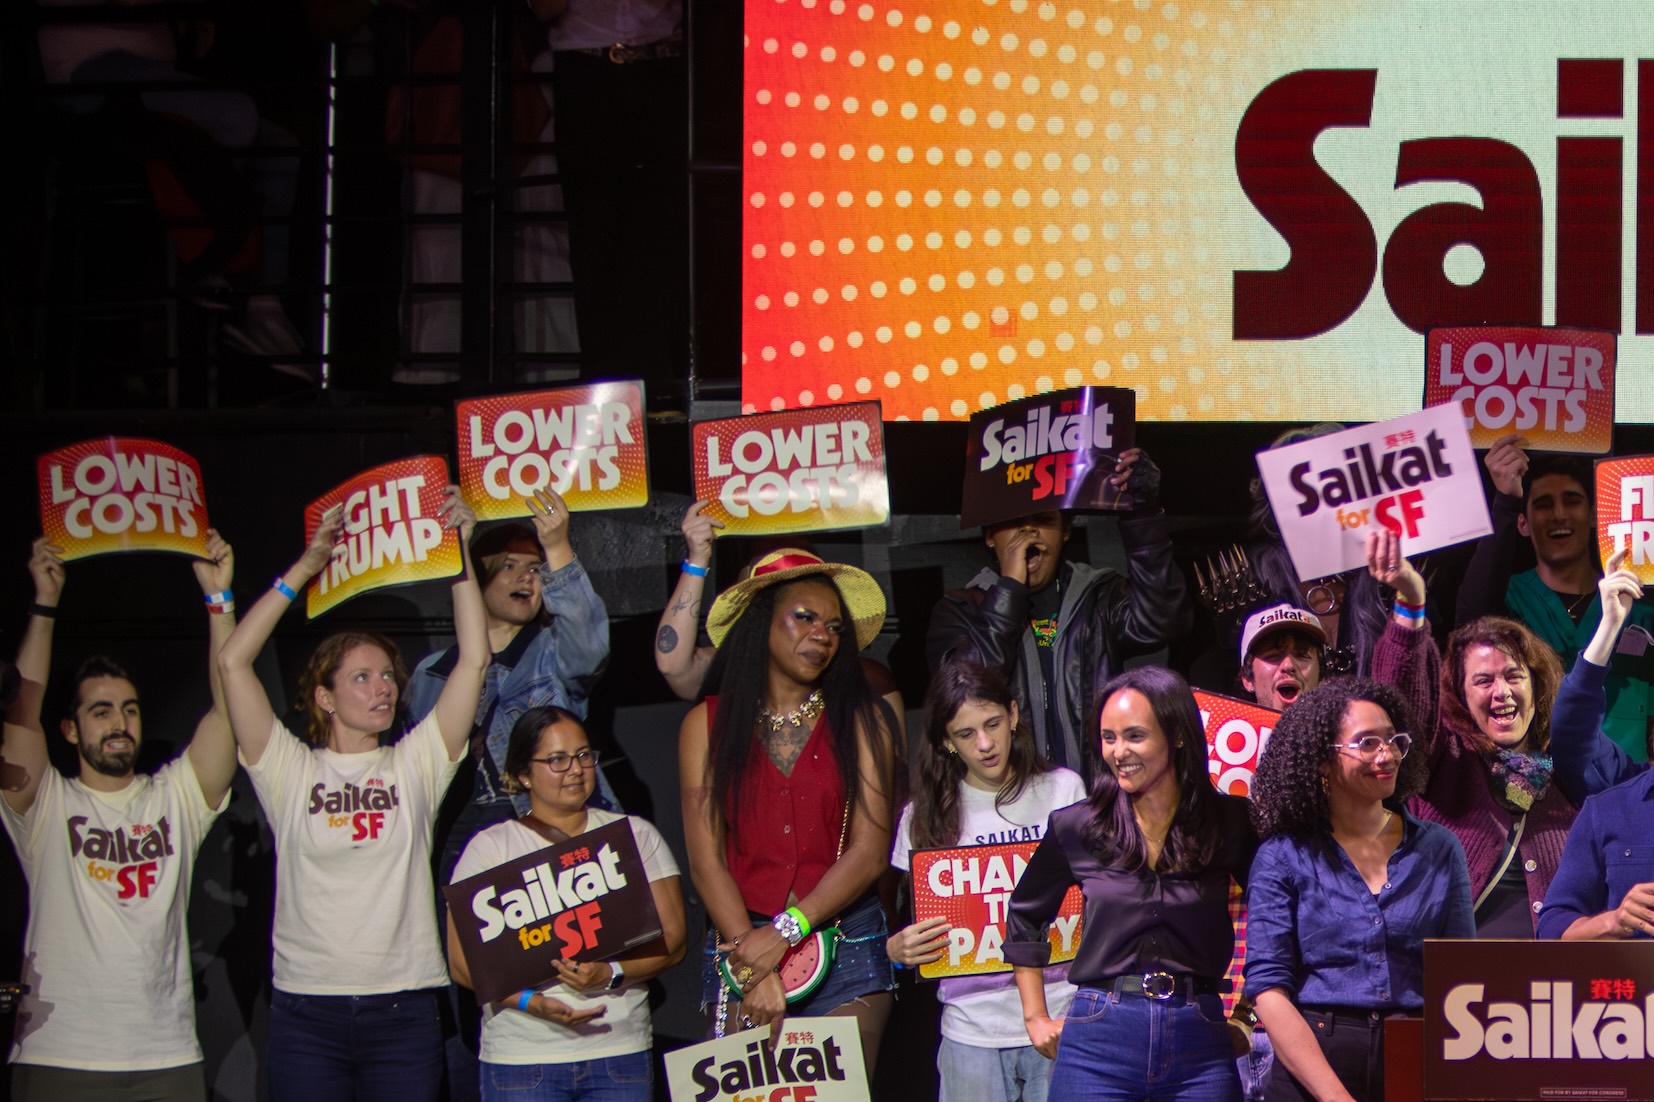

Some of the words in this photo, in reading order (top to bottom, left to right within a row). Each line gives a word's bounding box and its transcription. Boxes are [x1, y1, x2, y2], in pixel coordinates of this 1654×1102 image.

[1439, 342, 1604, 390] LOWER
[470, 402, 635, 458] LOWER
[1451, 385, 1588, 433] COSTS
[707, 420, 873, 477] LOWER
[980, 402, 1114, 472] Saikat
[51, 453, 202, 506] LOWER
[483, 446, 621, 500] COSTS
[720, 464, 860, 518] COSTS
[1006, 461, 1034, 485] for
[1032, 449, 1078, 502] SF
[1289, 428, 1455, 517] Saikat
[64, 492, 198, 540] COSTS
[321, 475, 426, 544] GHT
[1336, 507, 1371, 531] for
[1374, 489, 1426, 541] SF
[1258, 609, 1304, 628] Saikat
[309, 782, 399, 815] Saikat
[66, 815, 175, 864] Saikat
[328, 814, 350, 829] for
[351, 812, 385, 841] SF
[975, 824, 1041, 845] SAIKAT
[87, 860, 115, 882] for
[117, 862, 158, 900] SF
[472, 841, 628, 944] Saikat
[928, 853, 1034, 897] CHA
[518, 922, 553, 952] for
[558, 901, 603, 959] SF
[949, 914, 1081, 967] PAY
[1590, 979, 1636, 1000] 賽特
[784, 1031, 815, 1046] 賽特
